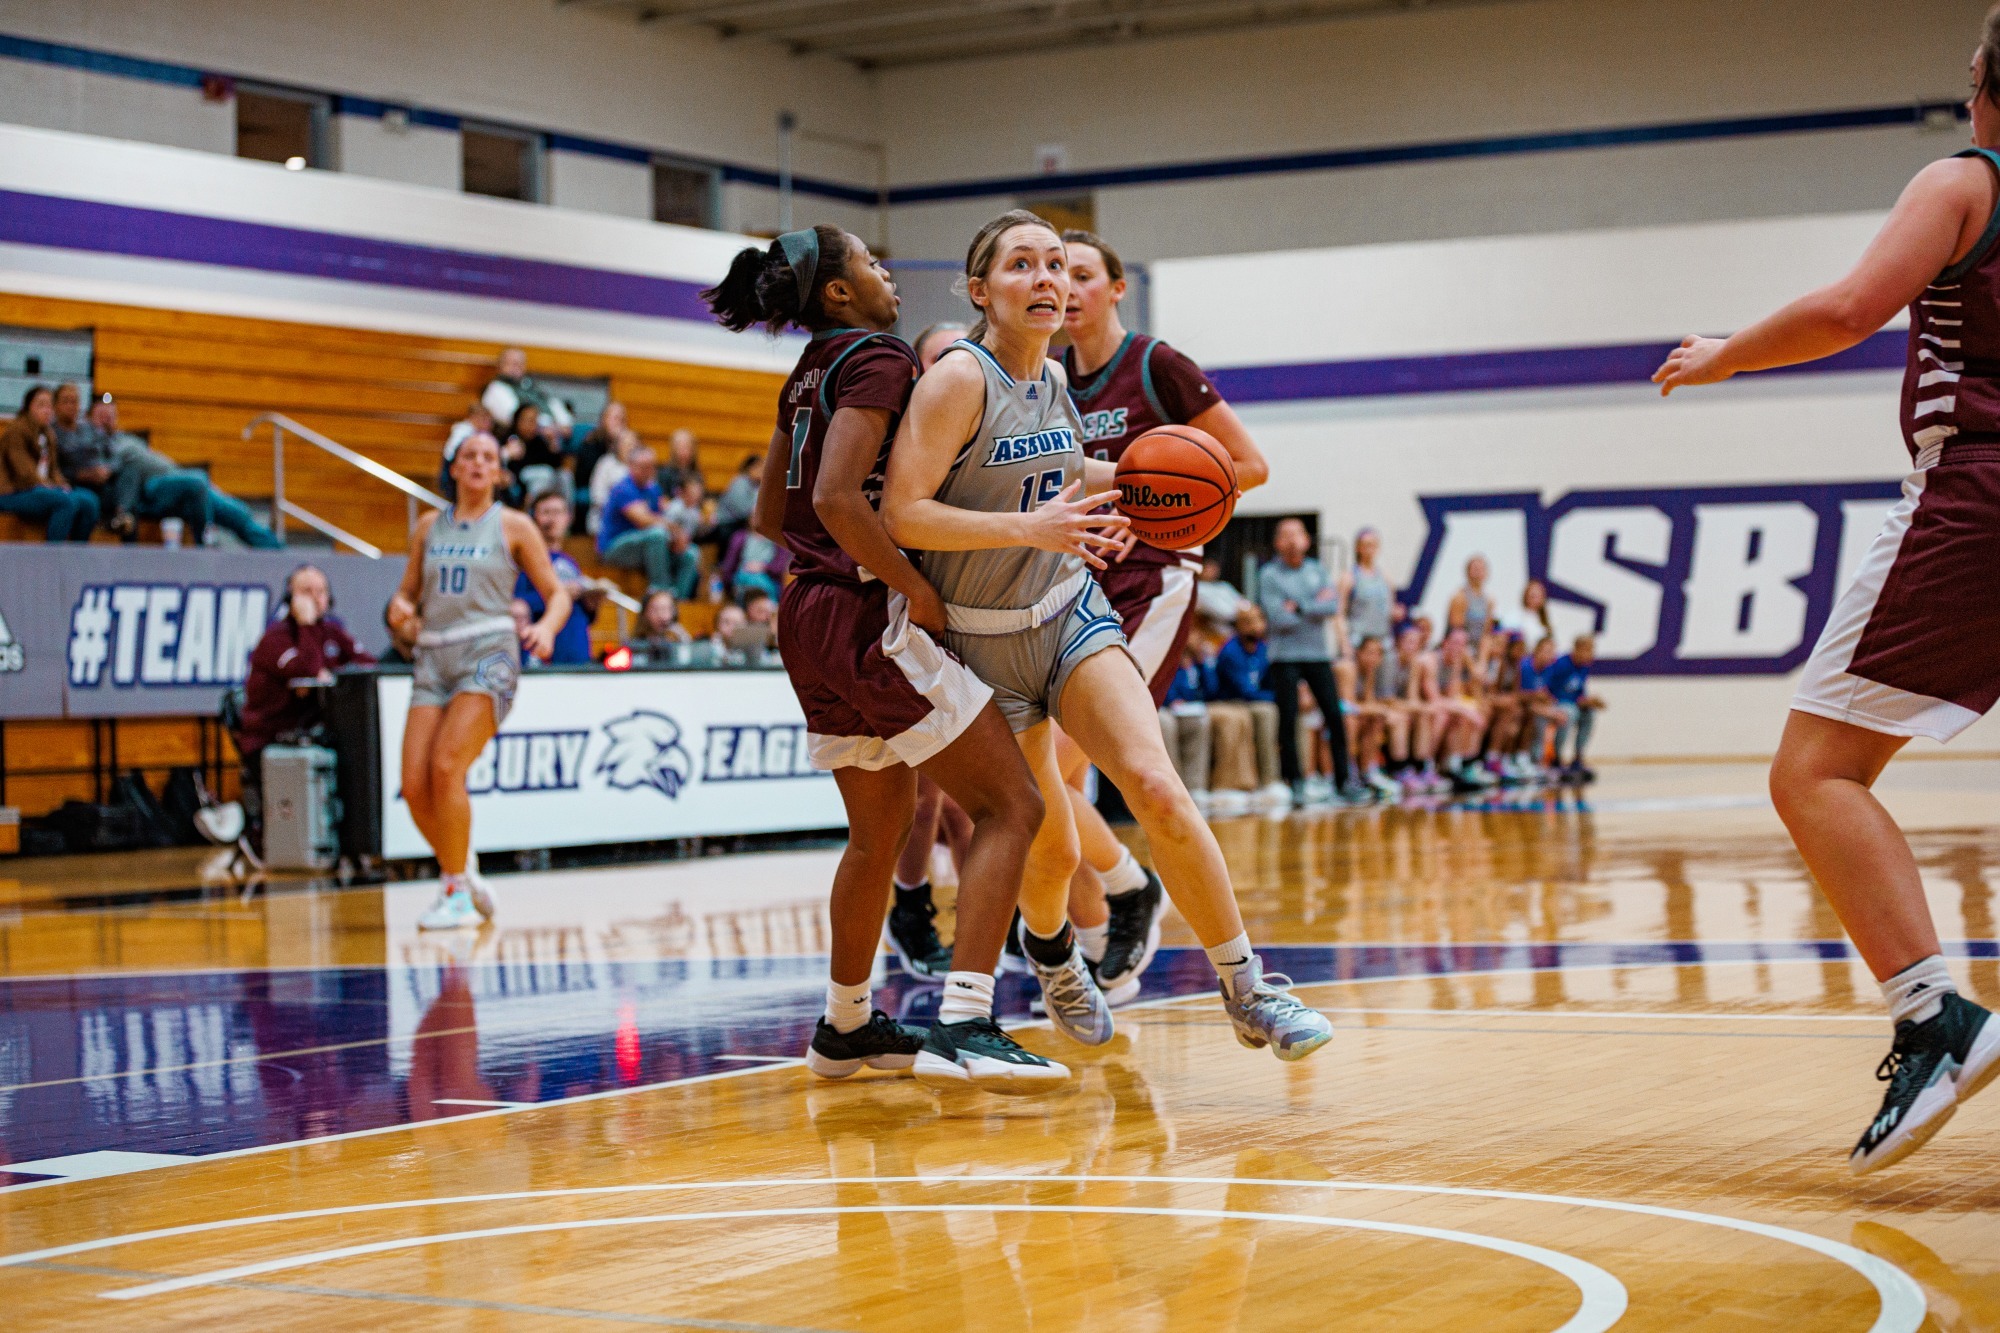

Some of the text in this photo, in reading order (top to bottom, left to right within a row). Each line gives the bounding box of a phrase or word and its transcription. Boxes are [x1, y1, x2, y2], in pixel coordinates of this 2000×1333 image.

[986, 428, 1074, 465] ASBURY
[1019, 468, 1064, 513] 15
[1118, 483, 1191, 508] Wilson
[440, 565, 466, 594] 10
[705, 725, 820, 781] EAGL
